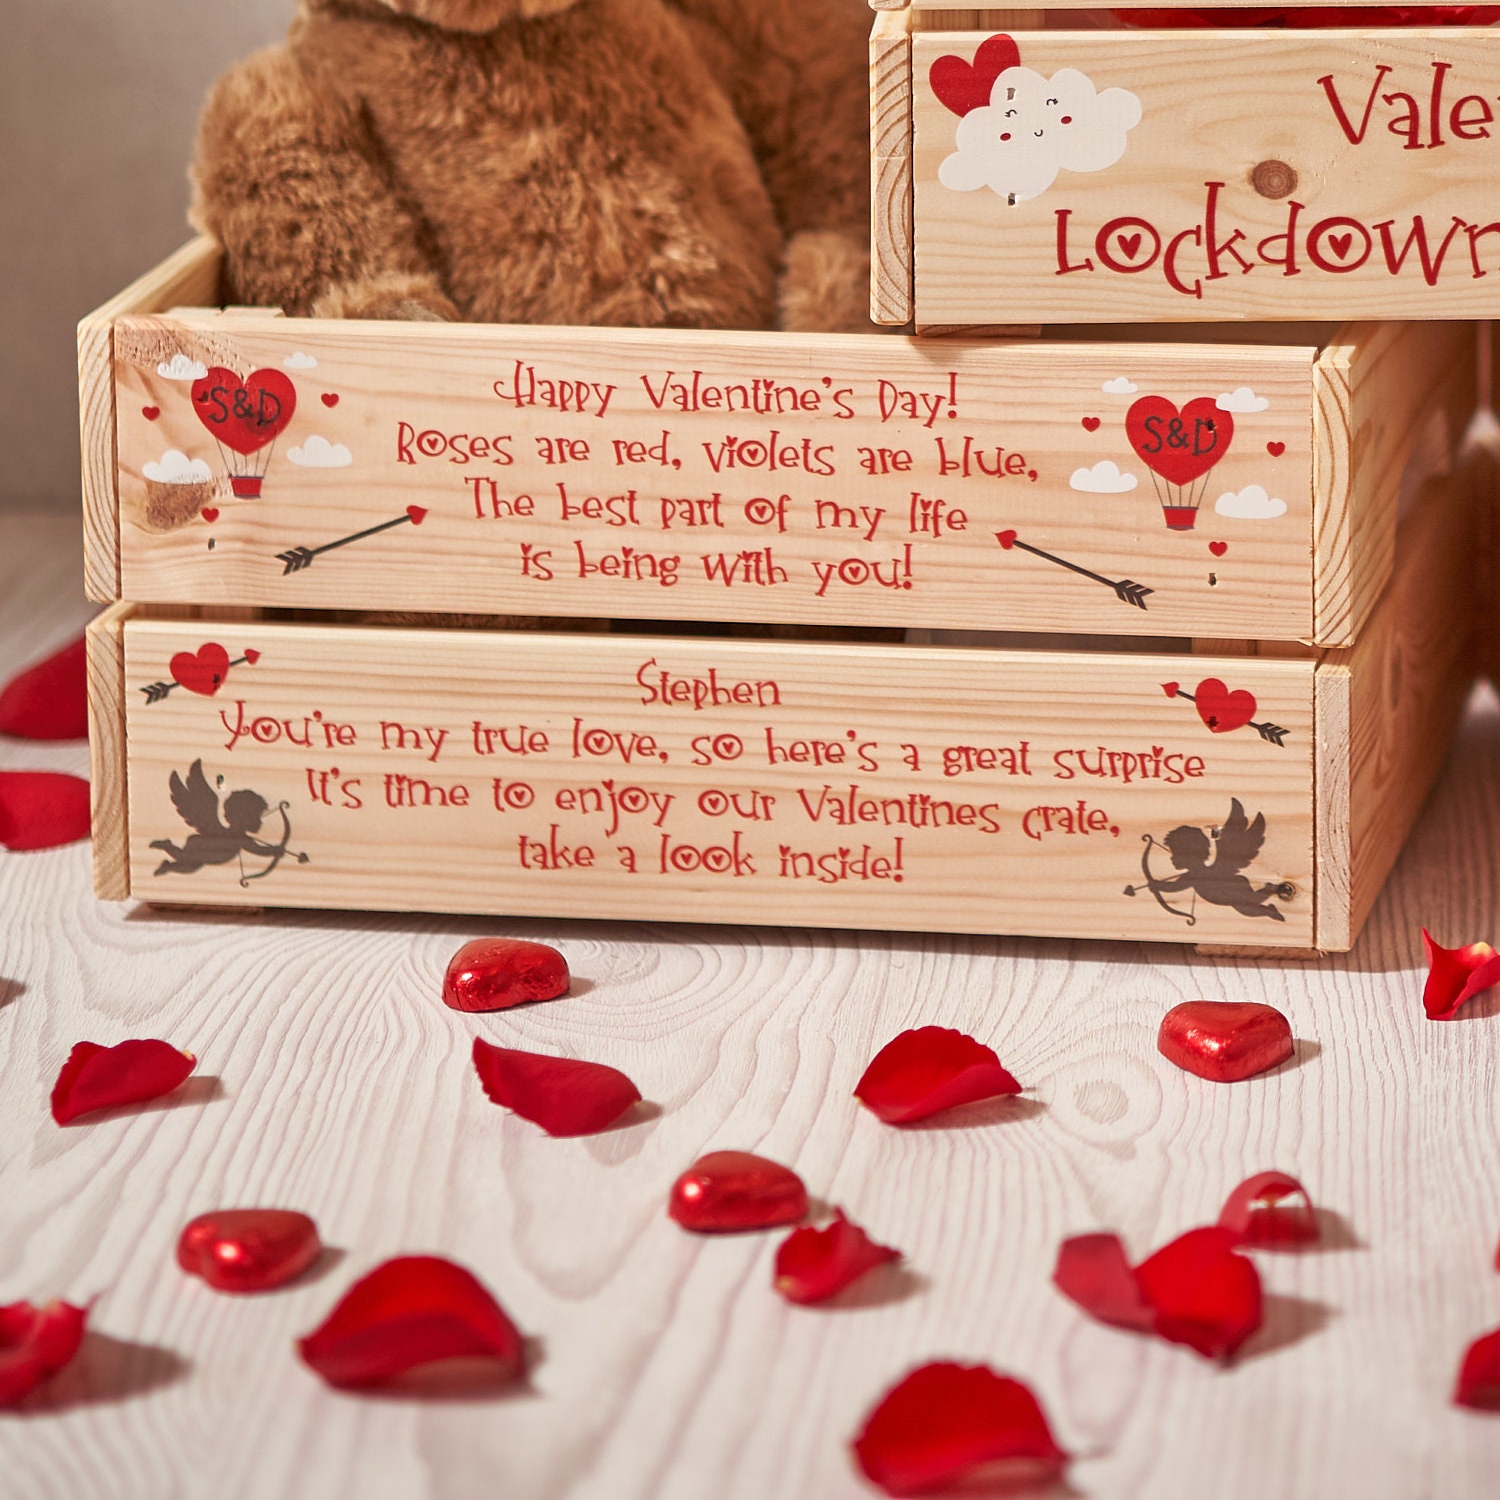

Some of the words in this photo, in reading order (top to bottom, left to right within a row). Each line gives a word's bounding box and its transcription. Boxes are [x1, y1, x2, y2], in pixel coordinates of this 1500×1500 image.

[207, 385, 282, 427] S&D
[493, 360, 618, 418] Happy
[640, 370, 855, 419] Valentine's
[877, 372, 958, 428] Day!
[397, 422, 514, 465] Roses
[535, 436, 590, 464] are
[612, 430, 682, 470] red,
[701, 431, 836, 476] violets
[857, 447, 913, 475] are
[935, 437, 1038, 482] blue,
[1142, 415, 1218, 457] S&D
[464, 476, 535, 519] The
[556, 482, 640, 527] best
[660, 493, 725, 530] part
[744, 494, 792, 533] of
[815, 500, 887, 542] my
[909, 492, 969, 538] life
[520, 543, 553, 581] is
[574, 540, 681, 587] being
[701, 547, 789, 588] with
[811, 543, 913, 597] you!
[636, 658, 782, 710] Stephen
[219, 700, 357, 751] You're
[379, 721, 450, 762] my
[472, 721, 550, 756] true
[572, 717, 669, 764] love,
[691, 734, 744, 766] so
[764, 727, 880, 772] here's
[900, 743, 922, 772] a
[942, 741, 1033, 777] great
[1053, 745, 1206, 784] surprise
[305, 767, 364, 809] It's
[384, 773, 470, 808] time
[492, 778, 536, 812] to
[555, 779, 676, 838] enjoy
[697, 790, 776, 821] our
[797, 784, 1001, 834] Valentines
[1022, 800, 1121, 841] crate,
[518, 823, 596, 871] take
[617, 845, 639, 874] a
[659, 831, 758, 877] look
[777, 837, 905, 884] inside!
